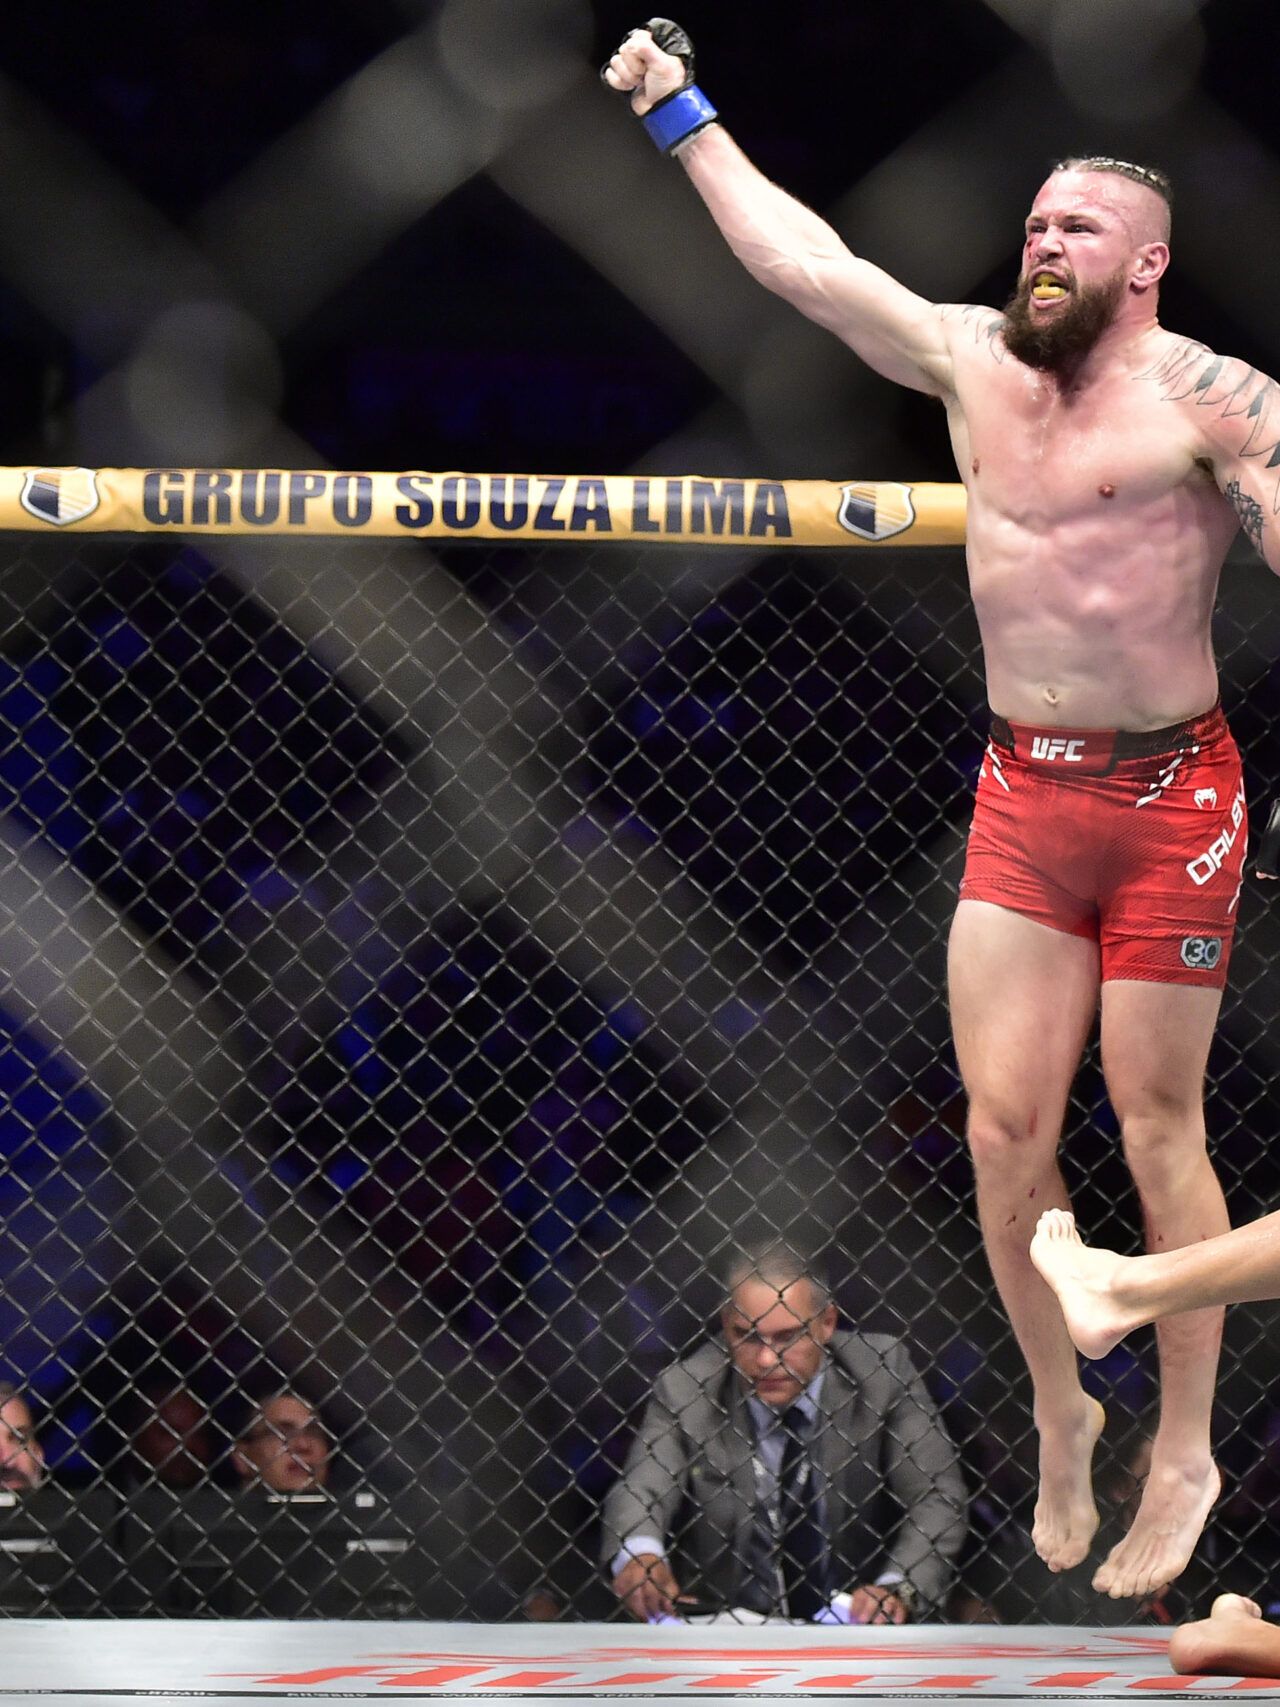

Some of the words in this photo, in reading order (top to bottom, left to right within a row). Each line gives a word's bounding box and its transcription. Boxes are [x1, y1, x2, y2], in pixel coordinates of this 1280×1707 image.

[143, 470, 373, 527] GRUPO
[395, 475, 614, 532] SOUZA
[632, 479, 793, 537] LIMA
[1030, 736, 1085, 762] UFC
[1185, 939, 1220, 965] 30
